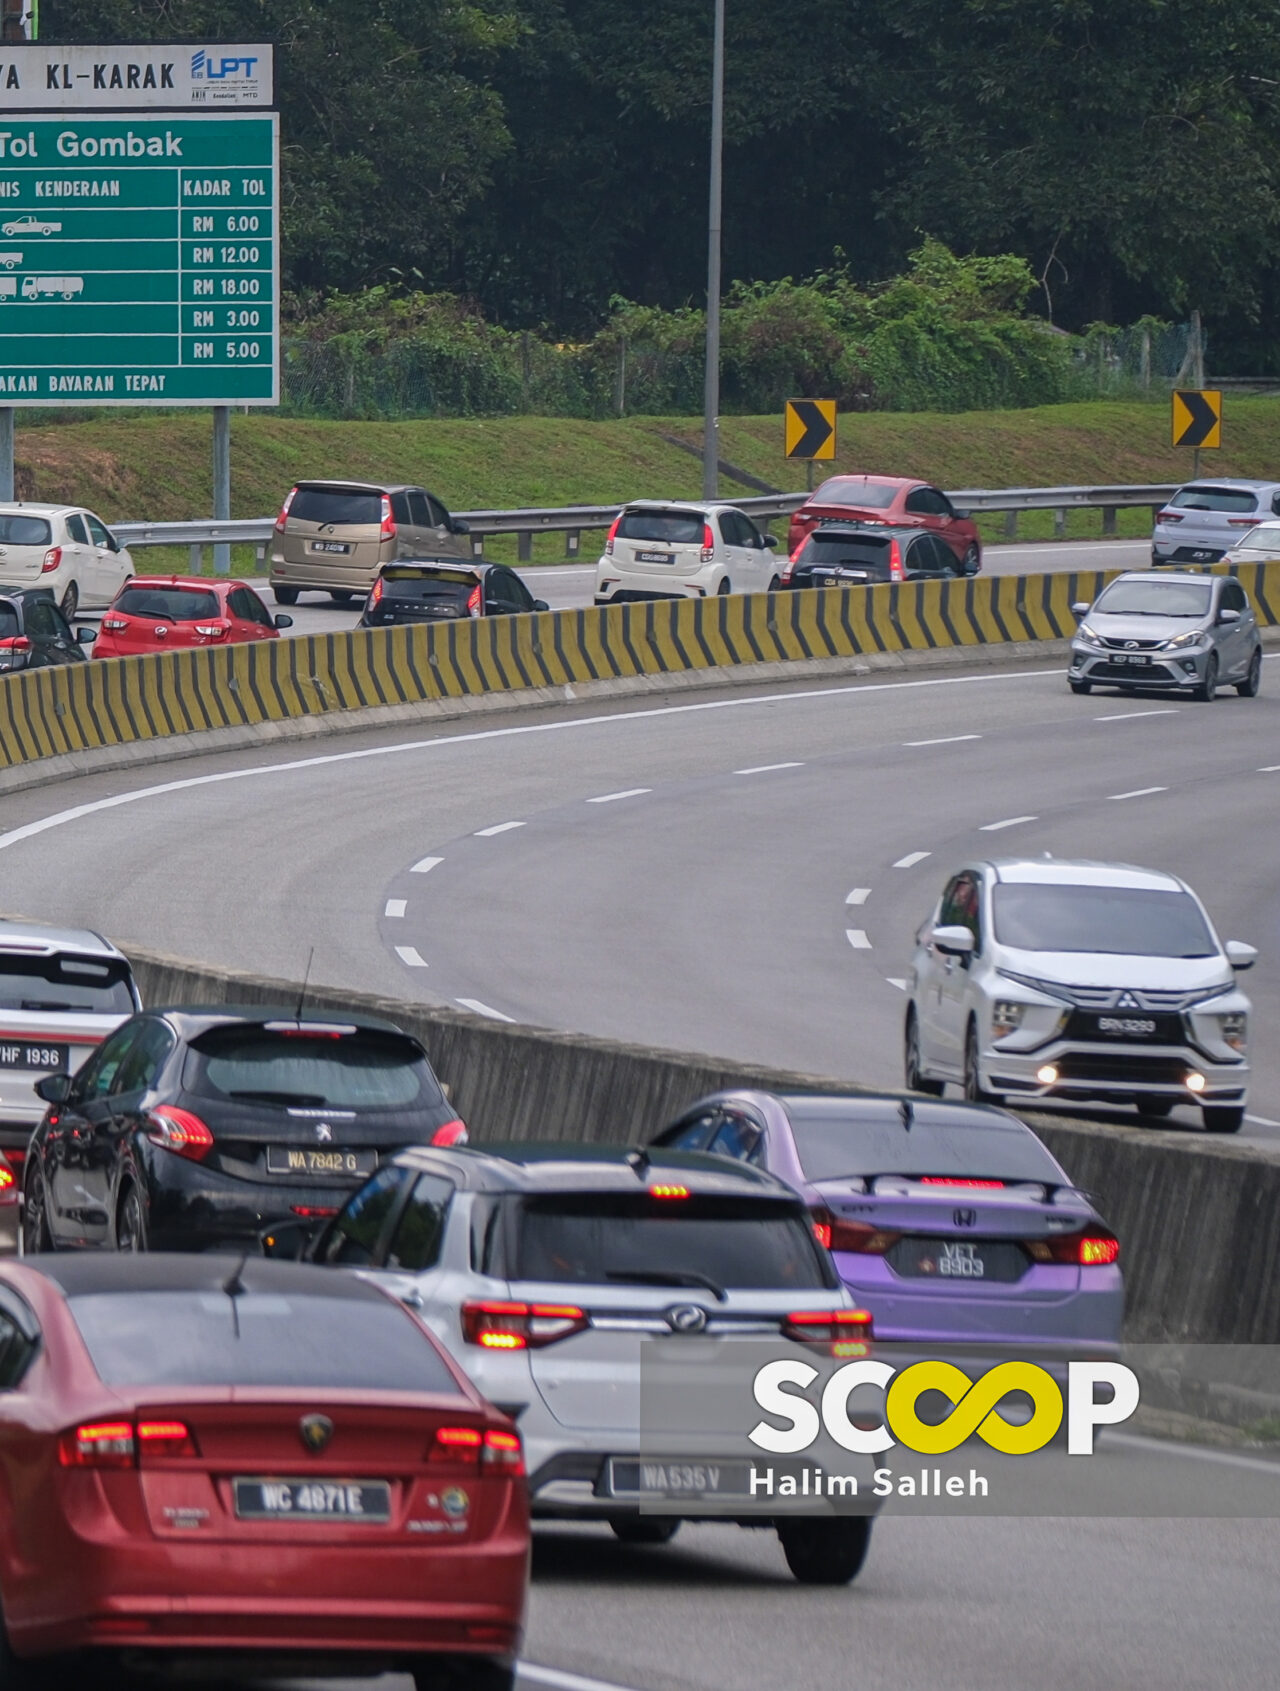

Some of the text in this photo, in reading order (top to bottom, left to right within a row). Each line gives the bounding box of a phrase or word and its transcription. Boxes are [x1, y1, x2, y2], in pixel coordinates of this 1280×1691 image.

[47, 63, 175, 89] KL-KARAK
[207, 57, 258, 78] LPT
[57, 131, 183, 158] Gombak
[36, 180, 119, 197] KENDERAAN
[183, 179, 265, 197] KADAR TOL
[193, 215, 259, 232] RM 6.00
[193, 247, 259, 263] RM 12.00
[193, 278, 259, 295] RM 18.00
[193, 311, 260, 327] RM 3.00
[193, 342, 260, 358] RM 5.00
[49, 375, 114, 392] BAYARAN
[125, 375, 165, 392] TEPAT
[26, 1048, 59, 1066] 1936
[288, 1151, 356, 1170] WA 7842 G
[943, 1241, 977, 1258] VET
[262, 1483, 292, 1511] WC
